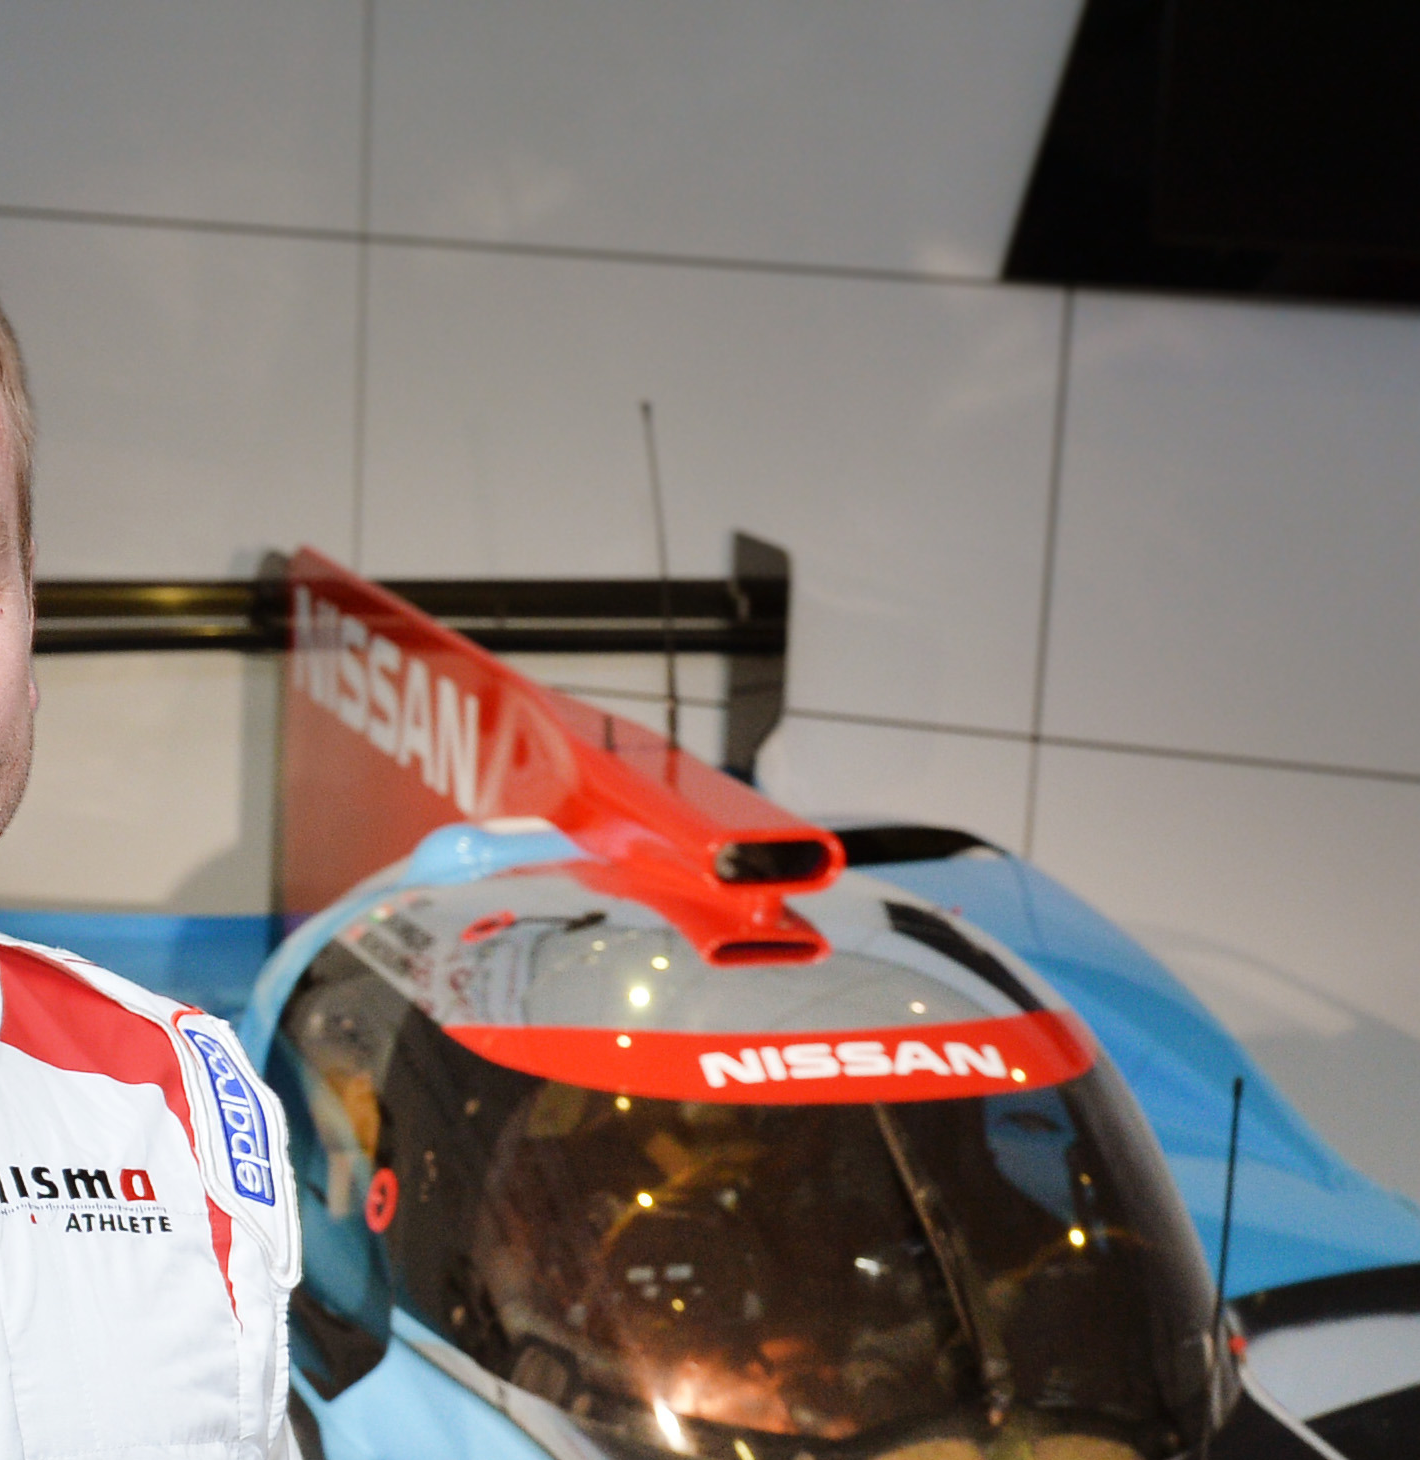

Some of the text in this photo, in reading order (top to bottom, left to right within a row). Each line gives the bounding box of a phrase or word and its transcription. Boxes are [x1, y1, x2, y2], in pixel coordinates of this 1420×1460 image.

[293, 583, 480, 818] NISSAN
[193, 1032, 271, 1198] sparco
[698, 1040, 1009, 1088] NISSAN
[65, 1212, 173, 1235] ATHLETE
